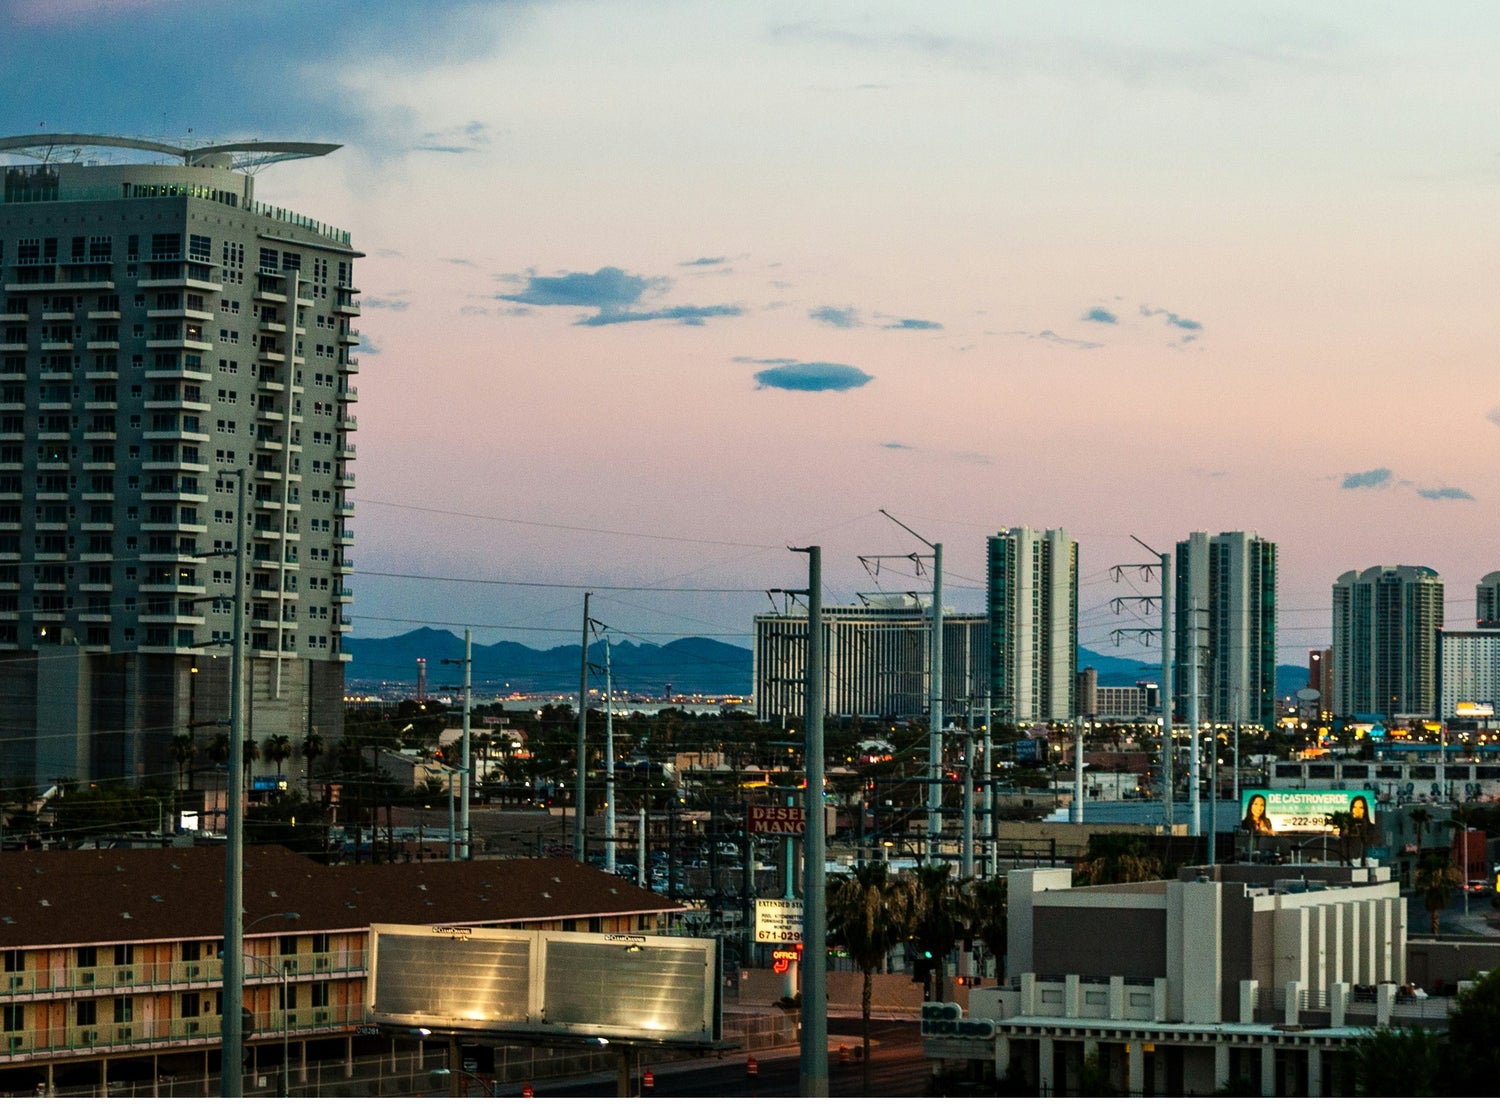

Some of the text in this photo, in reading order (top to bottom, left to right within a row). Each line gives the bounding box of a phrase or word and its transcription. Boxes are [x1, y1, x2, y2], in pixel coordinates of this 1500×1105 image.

[1268, 793, 1348, 804] DE CASTROVERDE
[772, 951, 798, 960] OFFICE
